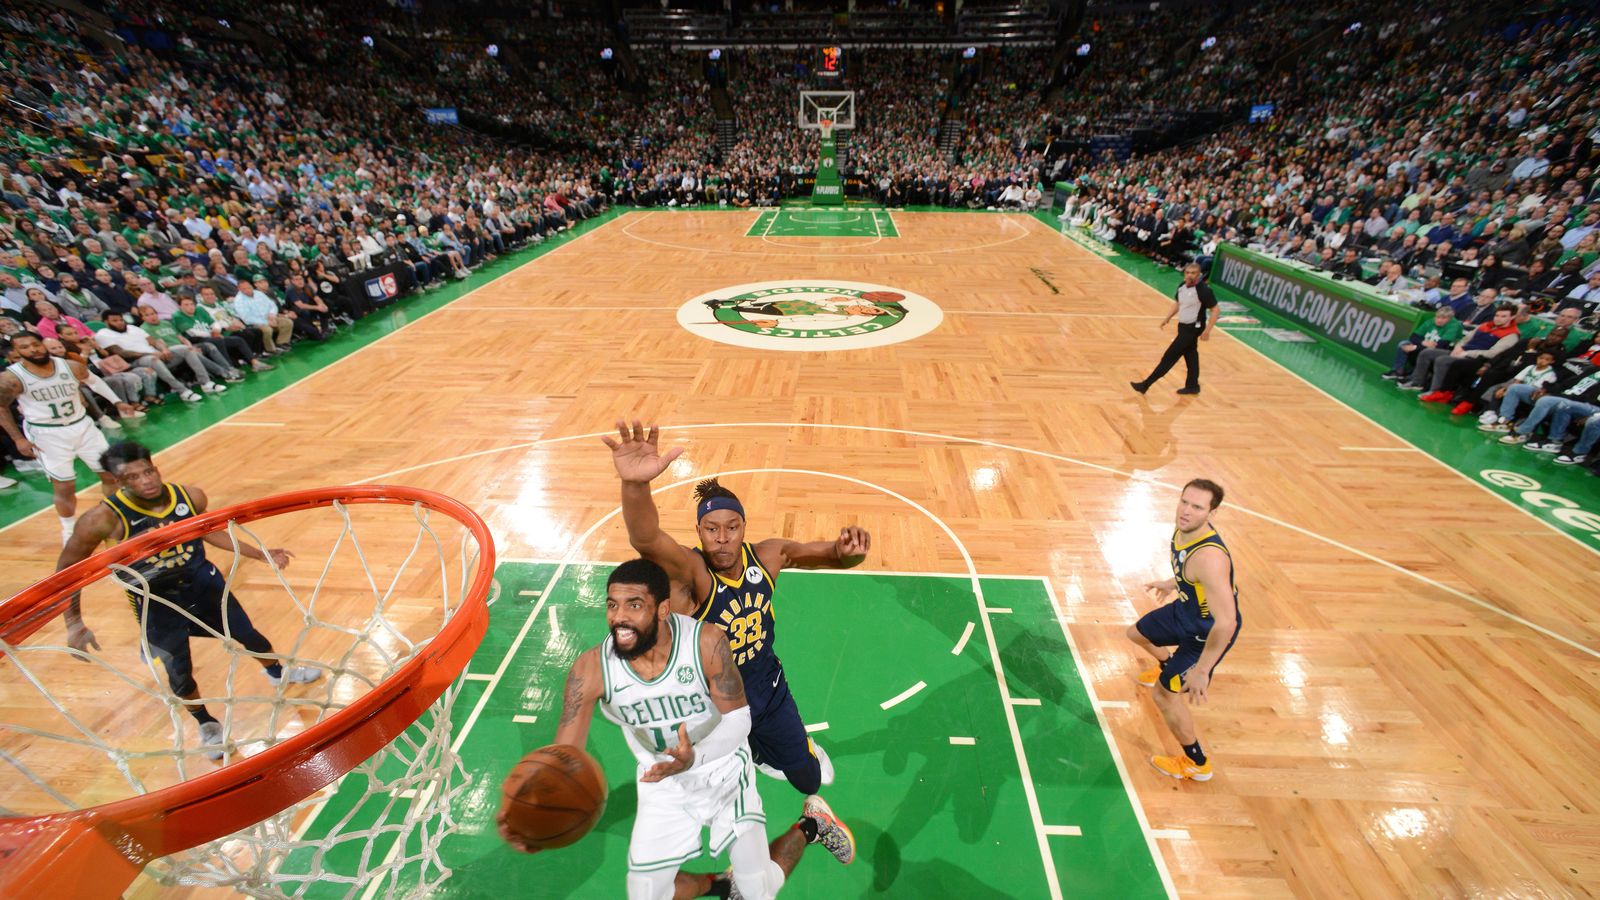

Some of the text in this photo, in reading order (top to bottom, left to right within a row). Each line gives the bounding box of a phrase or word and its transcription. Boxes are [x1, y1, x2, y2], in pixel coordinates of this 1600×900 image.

[824, 56, 837, 71] 12
[752, 287, 861, 297] BOSTON
[1220, 257, 1396, 352] VISIT CELTICS.COM/SHOP
[756, 323, 884, 338] CELTICS
[31, 383, 76, 402] CELTICS
[47, 401, 75, 419] 13
[1480, 469, 1600, 541] @ce
[730, 610, 762, 651] 33
[618, 692, 706, 726] CELTICS
